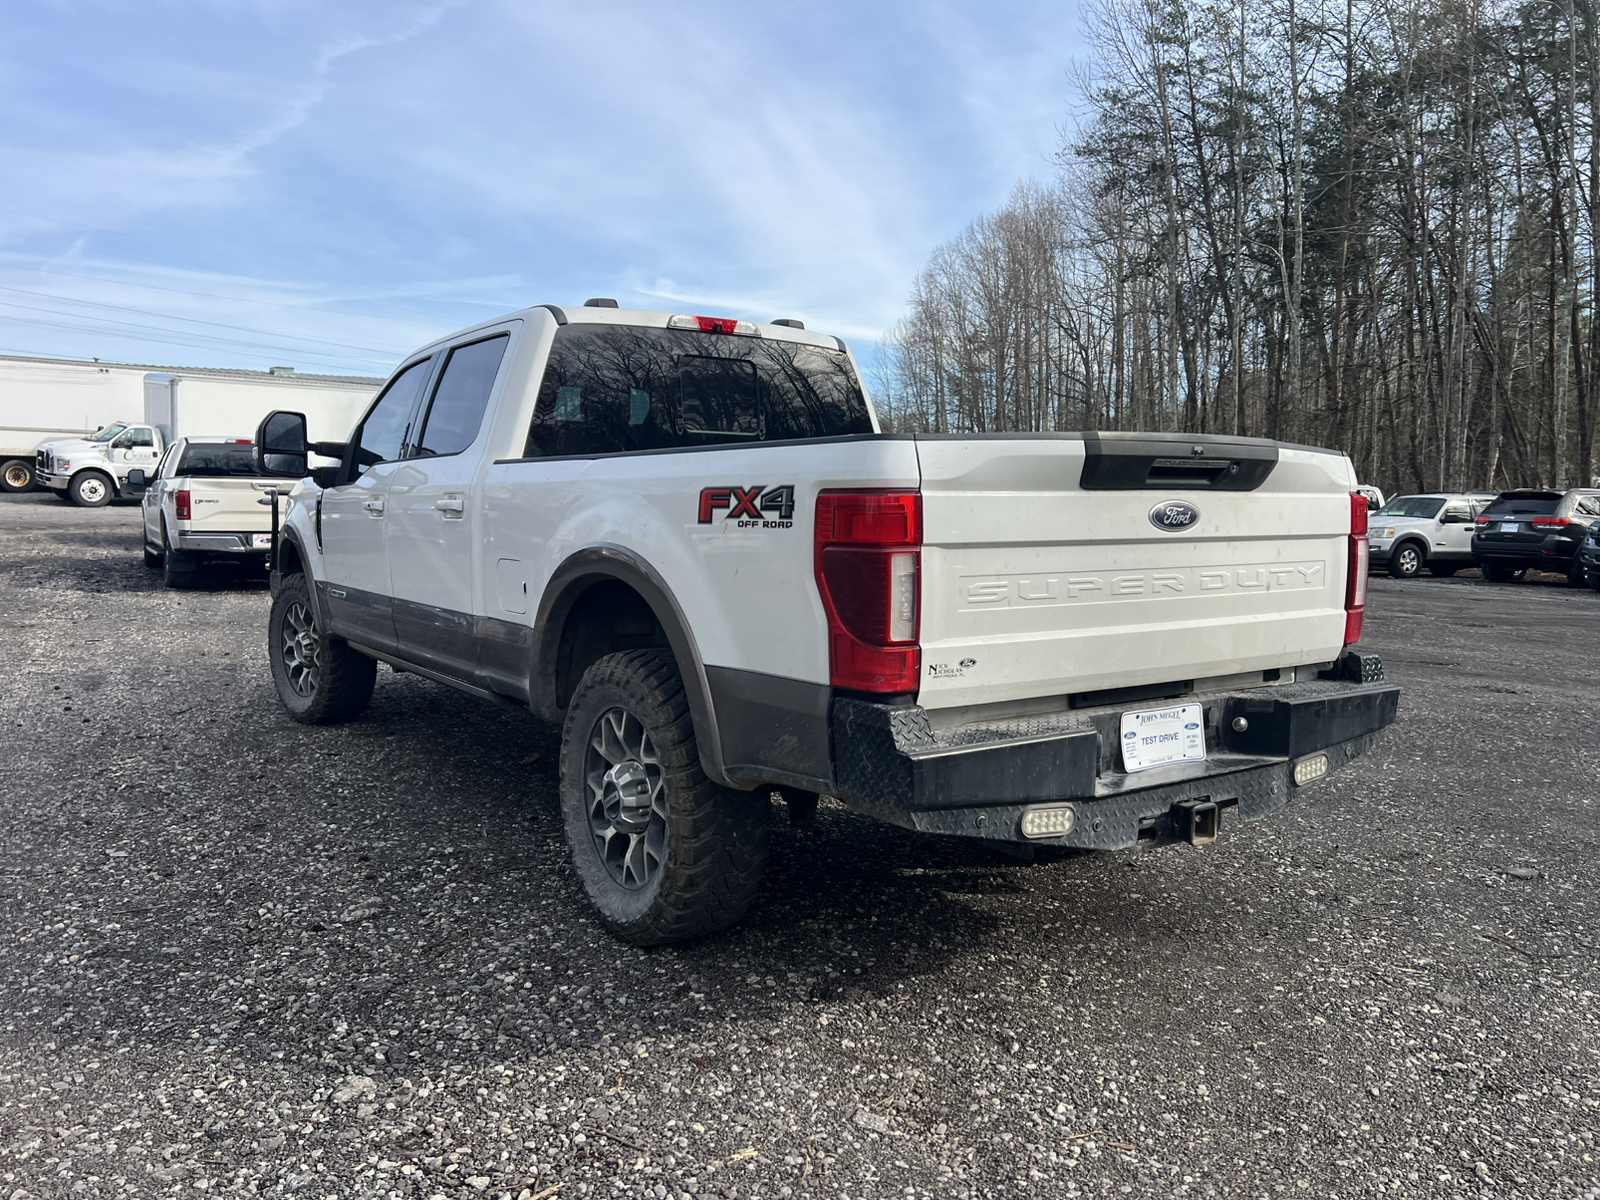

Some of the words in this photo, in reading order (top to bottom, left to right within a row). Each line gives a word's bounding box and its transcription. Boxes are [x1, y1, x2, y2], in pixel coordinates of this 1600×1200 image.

[697, 484, 795, 525] FX4
[1163, 506, 1192, 524] Ford
[737, 520, 759, 528] OFF
[762, 520, 793, 529] ROAD
[966, 572, 1185, 604] SUPER
[1200, 566, 1321, 591] DUTY
[1140, 714, 1158, 726] JOHN
[1141, 735, 1158, 746] TEST
[1158, 732, 1179, 743] DRIVE
